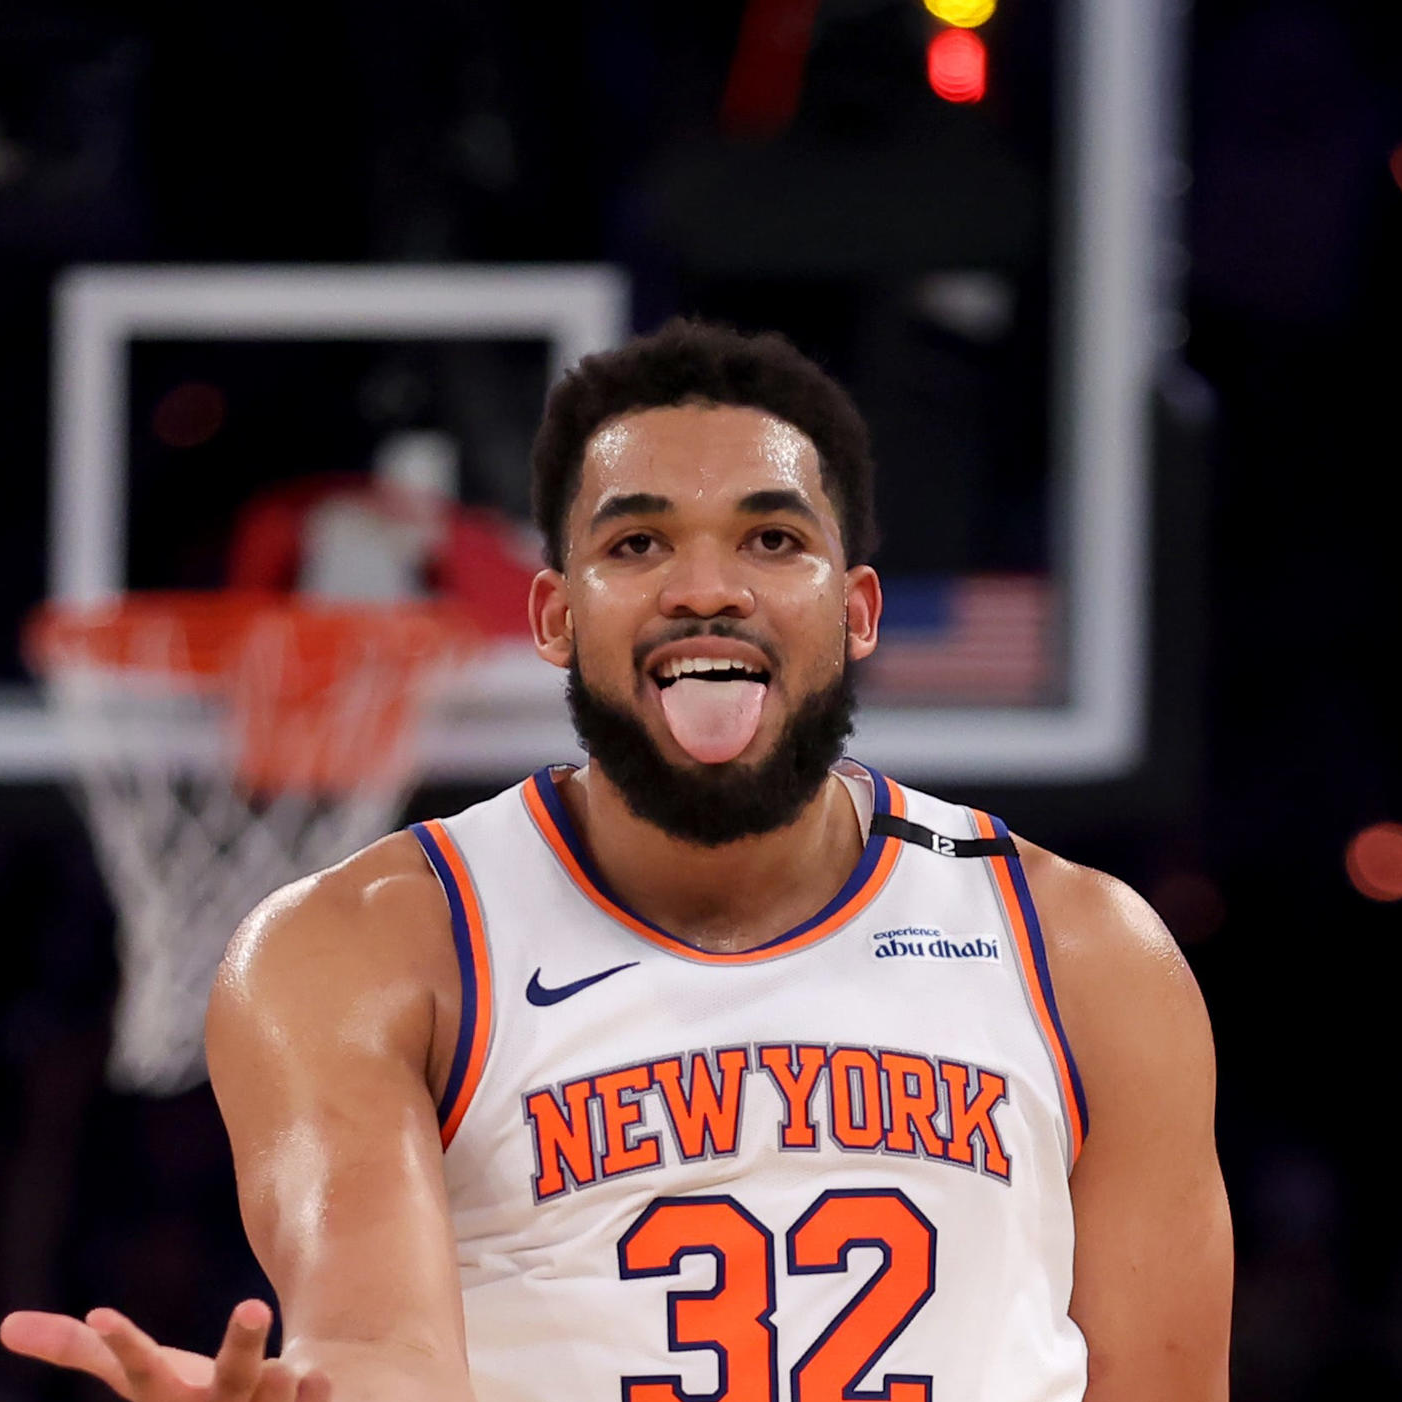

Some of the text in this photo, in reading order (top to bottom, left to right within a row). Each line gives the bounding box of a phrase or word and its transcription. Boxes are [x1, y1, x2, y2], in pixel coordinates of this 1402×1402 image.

[931, 834, 956, 857] 12
[873, 927, 941, 940] experience
[875, 938, 998, 959] abu dhabi
[523, 1041, 1012, 1206] NEW YORK
